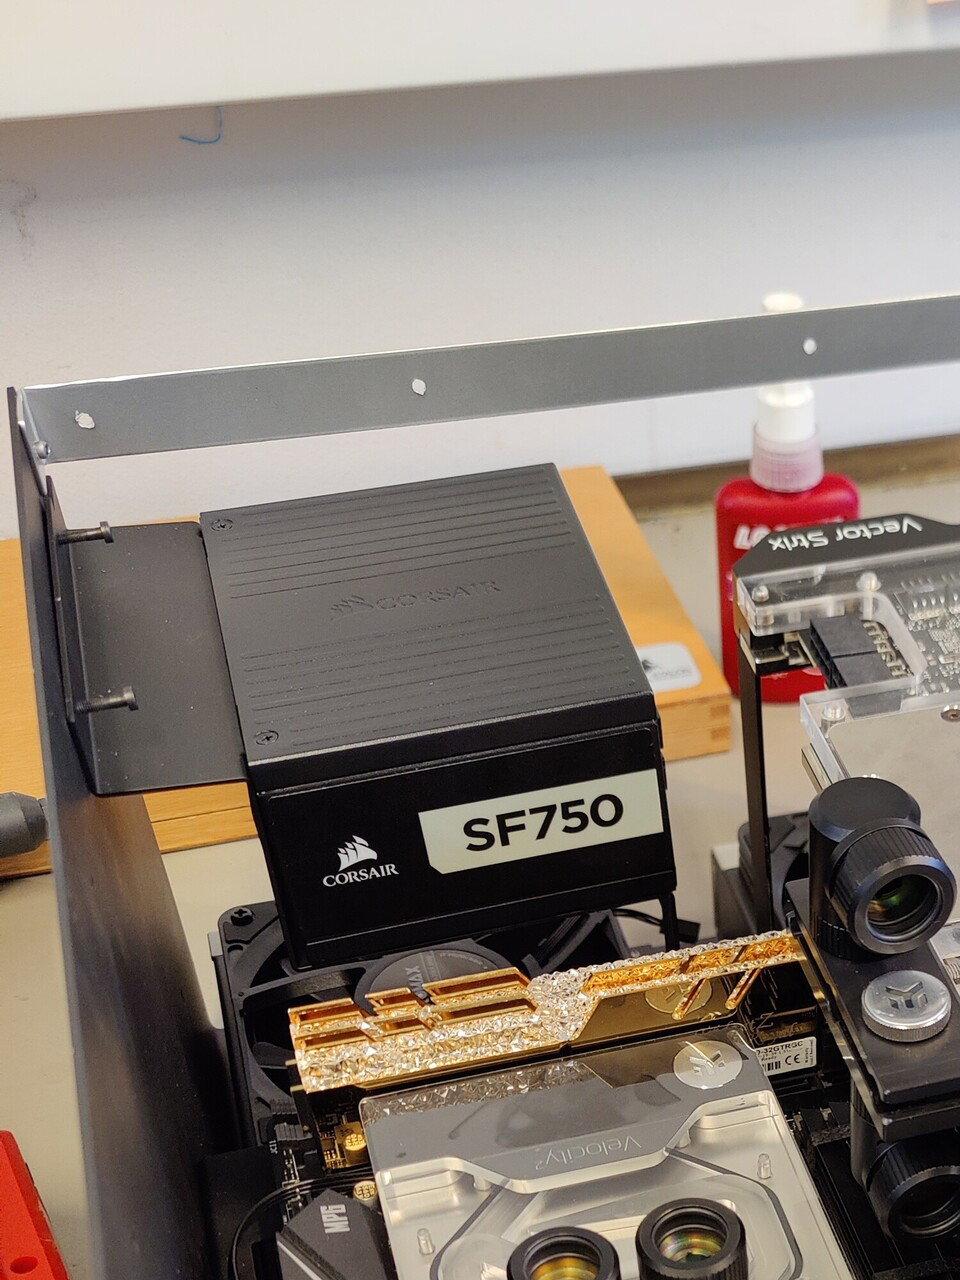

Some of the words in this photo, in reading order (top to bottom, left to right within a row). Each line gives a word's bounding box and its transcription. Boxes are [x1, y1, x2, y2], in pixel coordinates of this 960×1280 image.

[768, 529, 830, 551] Strix
[835, 517, 922, 542] Vector
[463, 793, 624, 852] SF750
[322, 863, 399, 887] CORSAIR
